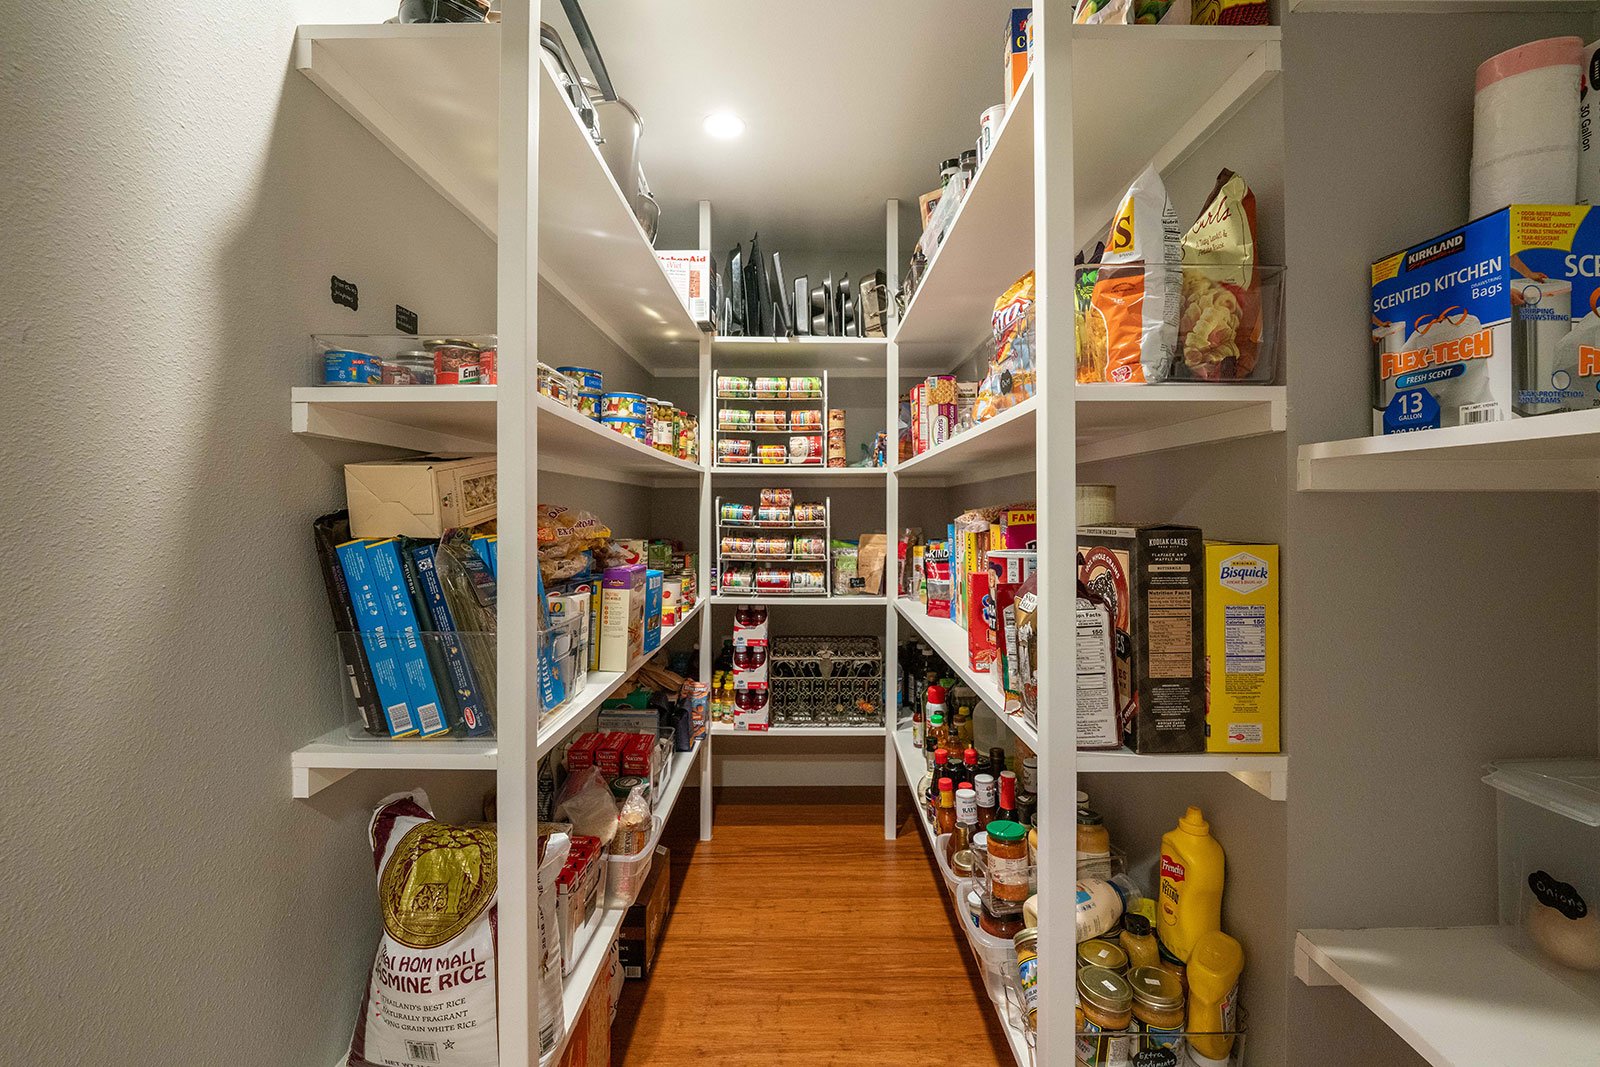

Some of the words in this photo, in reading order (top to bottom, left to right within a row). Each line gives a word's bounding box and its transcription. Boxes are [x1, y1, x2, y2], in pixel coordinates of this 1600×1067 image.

[1580, 104, 1590, 118] 30
[1581, 118, 1592, 152] Gallon
[1408, 236, 1464, 264] KIRKLAND
[1373, 282, 1430, 312] SCENTED
[1434, 256, 1502, 292] KITCHEN
[1472, 283, 1502, 300] Bags
[1381, 328, 1494, 380] FLEX-TECH
[1406, 373, 1427, 384] FRESH
[1428, 368, 1453, 380] SCENT
[1398, 392, 1423, 414] 13
[1398, 412, 1422, 422] GALLON
[1148, 538, 1170, 546] KODIAK
[930, 550, 950, 558] KIND
[1220, 566, 1268, 580] Bisquick
[1162, 859, 1184, 876] French's
[1536, 880, 1584, 912] Onions
[398, 956, 432, 973] HOM
[436, 948, 476, 972] MALI
[375, 962, 432, 994] SMINE
[438, 961, 487, 991] RICE
[382, 995, 422, 1012] THAILAND'S
[424, 1002, 444, 1012] BEST
[446, 998, 466, 1008] RICE
[382, 1006, 420, 1022] NATURALLY
[422, 1010, 468, 1022] FRAGRANT
[401, 1024, 426, 1032] GRAIN
[427, 1024, 456, 1033] WHITE
[457, 1020, 477, 1030] RICE
